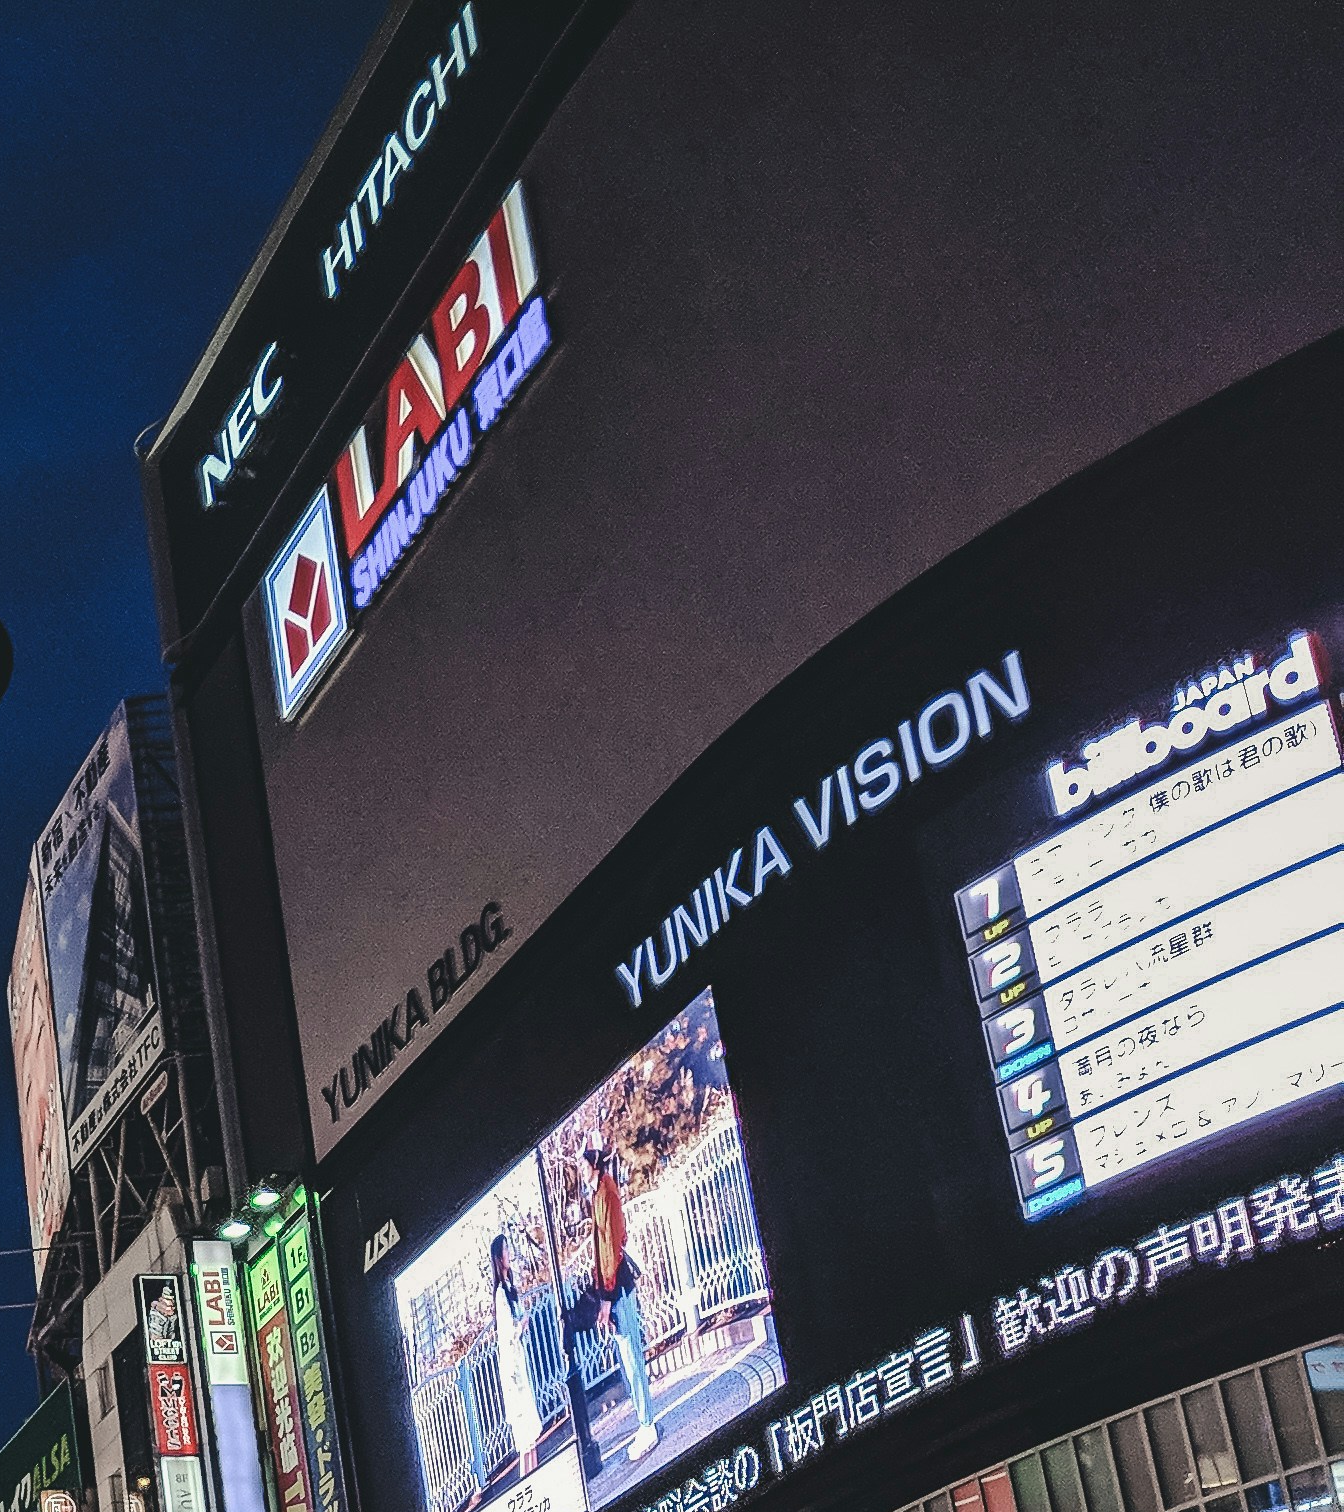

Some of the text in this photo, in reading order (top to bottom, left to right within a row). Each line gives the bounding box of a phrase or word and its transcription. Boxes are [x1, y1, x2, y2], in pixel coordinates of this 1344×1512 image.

[320, 2, 480, 299] HITACHI
[334, 179, 540, 560] LABI
[200, 342, 283, 510] NEC
[351, 411, 473, 610] SHINJUKU
[1173, 655, 1256, 712] JAPAN
[1044, 632, 1319, 818] billboard
[615, 828, 793, 1006] YUNIKA
[794, 650, 1032, 851] VISION
[982, 918, 1010, 941] UP
[982, 941, 1022, 987] 2
[1000, 981, 1027, 1004] UP
[996, 1007, 1036, 1054] 3
[320, 995, 427, 1124] YUNIKA
[999, 1042, 1054, 1079] DOWN
[1015, 1078, 1052, 1118] 4
[1027, 1117, 1054, 1138] UP
[1026, 1140, 1066, 1188] 5
[1028, 1178, 1083, 1216] DOWN
[202, 1271, 226, 1326] LABI
[257, 1281, 279, 1314] LABI
[295, 1287, 311, 1315] B1
[299, 1331, 316, 1359] B2
[507, 1486, 535, 1512] ウララ
